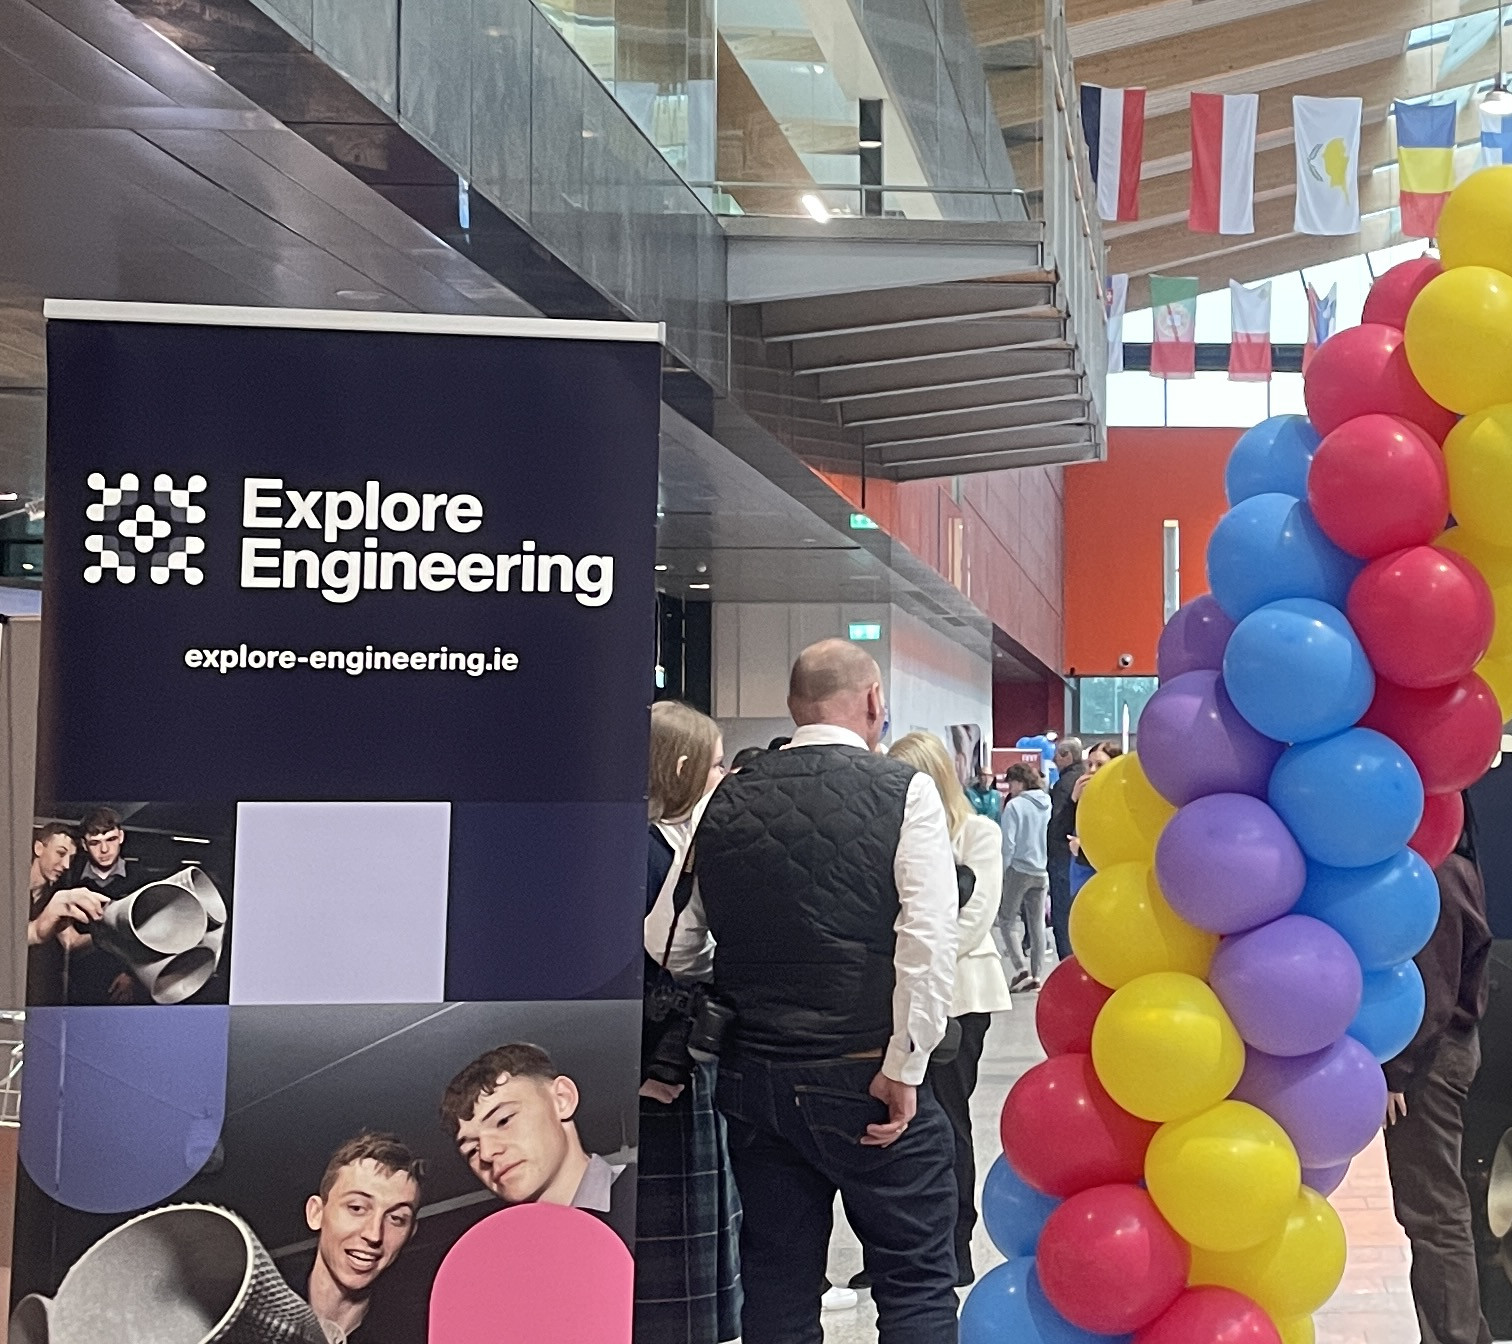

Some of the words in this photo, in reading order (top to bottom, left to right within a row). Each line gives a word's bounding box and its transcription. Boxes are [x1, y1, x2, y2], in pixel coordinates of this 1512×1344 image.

[242, 477, 484, 543] Explore
[240, 536, 614, 607] Engineering
[184, 643, 520, 678] explore-engineering.ie
